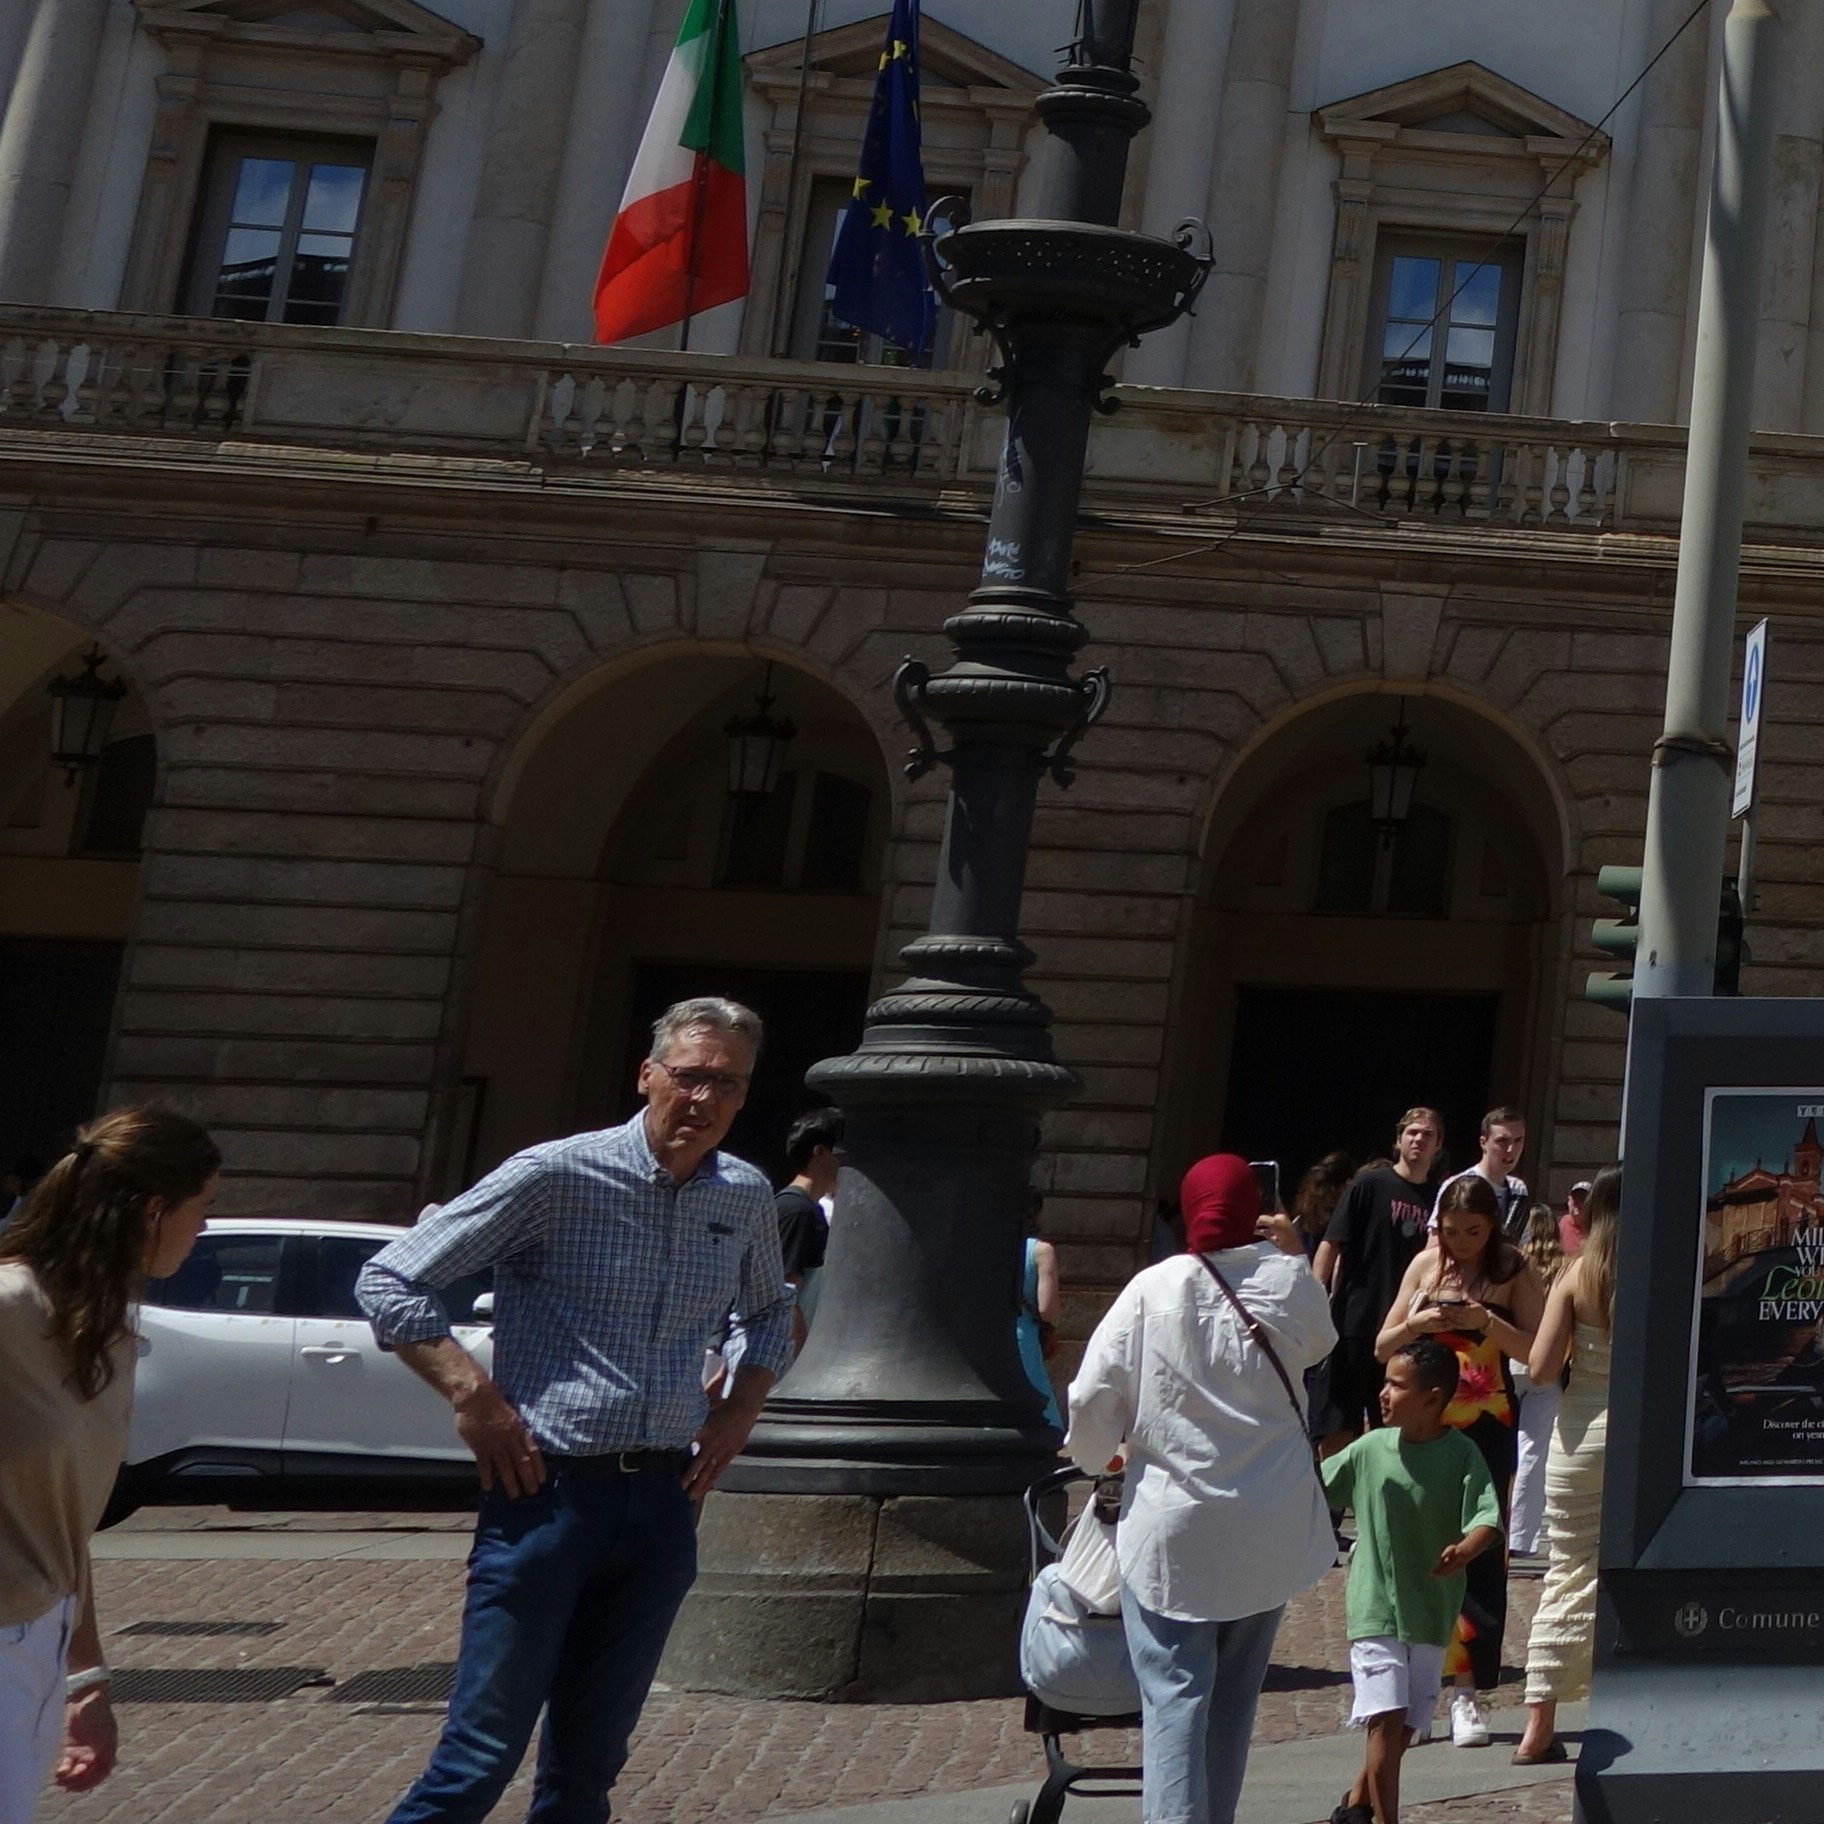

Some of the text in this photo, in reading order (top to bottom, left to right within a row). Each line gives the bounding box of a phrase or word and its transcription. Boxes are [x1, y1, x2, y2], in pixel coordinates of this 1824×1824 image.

[1795, 1266, 1820, 1277] YOU
[1763, 1418, 1800, 1429] Discover
[1801, 1418, 1815, 1428] the
[1718, 1607, 1820, 1629] Comune
